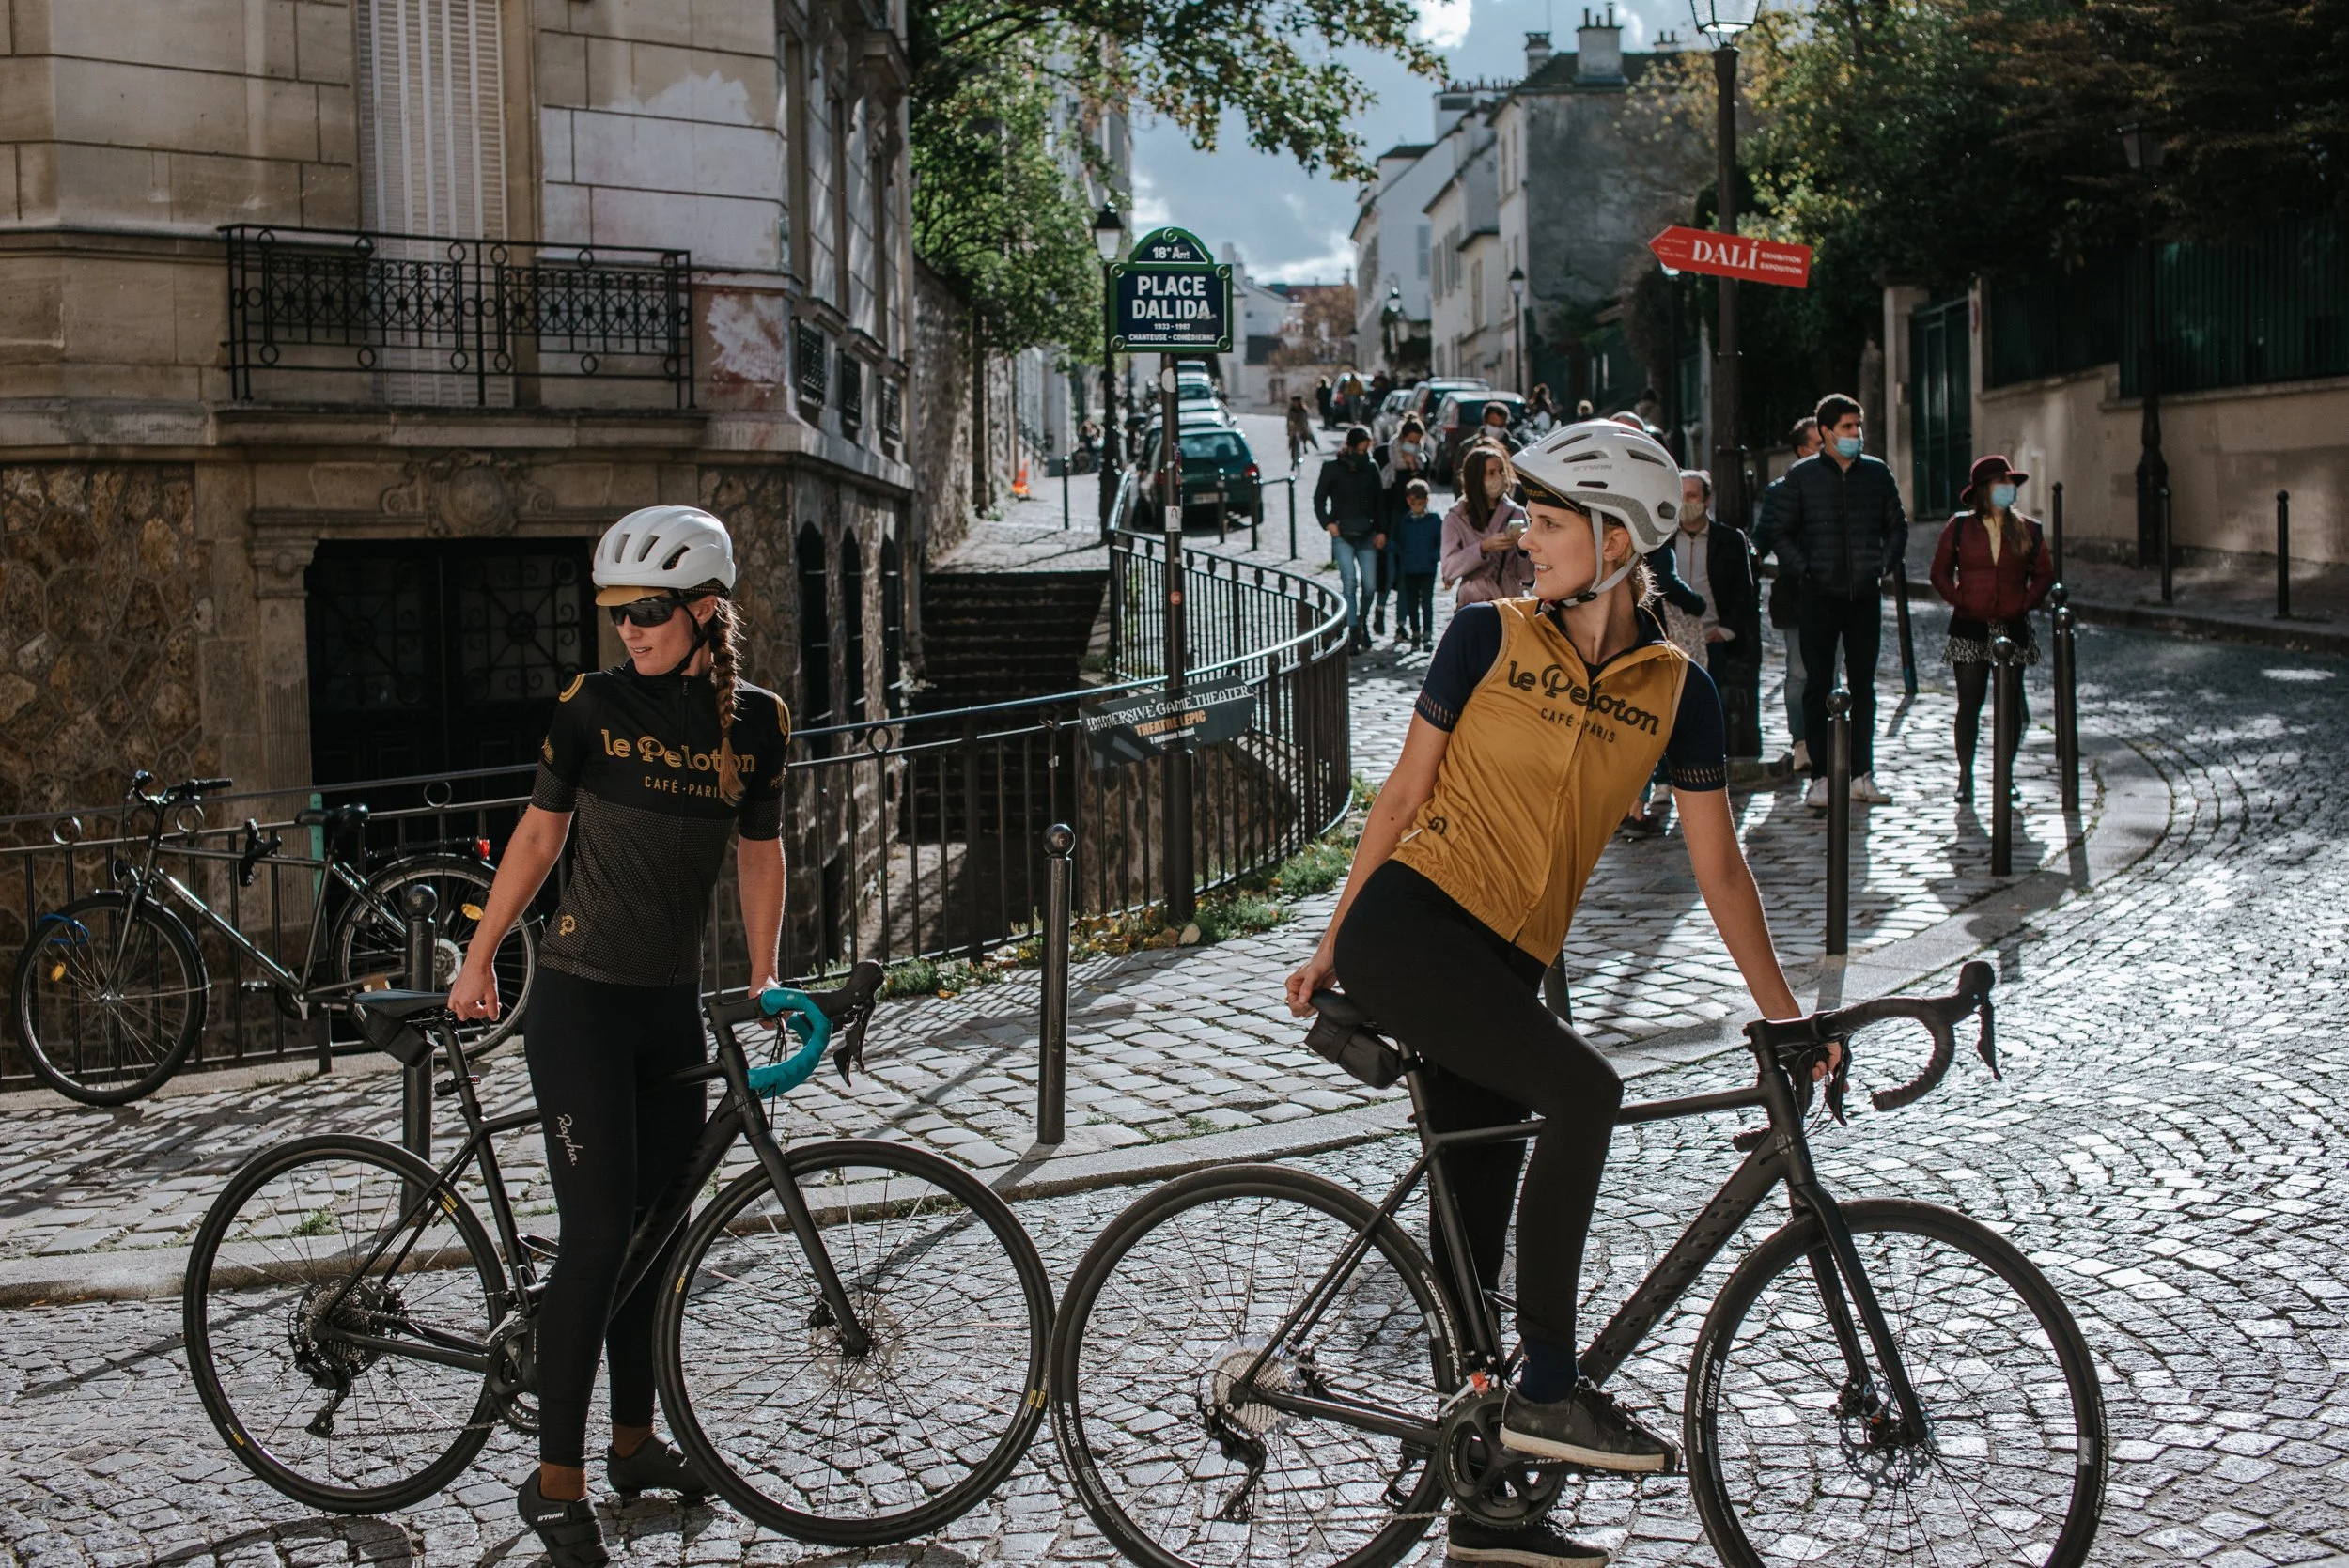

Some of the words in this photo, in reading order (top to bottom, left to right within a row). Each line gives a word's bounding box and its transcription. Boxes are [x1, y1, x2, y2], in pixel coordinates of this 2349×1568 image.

[1692, 240, 1759, 270] DALÍ
[1759, 262, 1803, 274] EXPOSITION
[1761, 252, 1802, 263] EXHIBITION
[1137, 275, 1206, 296] PLACE
[1132, 299, 1211, 319] DALIDA
[1086, 705, 1154, 731] IMMERSIVE
[1156, 696, 1192, 715] GAME
[1193, 685, 1252, 707] THEATER
[1508, 660, 1536, 691] le
[1541, 663, 1660, 736] Peloton
[1134, 717, 1178, 737] THEATRE
[1179, 710, 1206, 728] LEPIC
[1541, 707, 1573, 728] CAFÉ
[1583, 722, 1616, 743] PARIS
[600, 729, 631, 757] le
[645, 776, 677, 793] CAFÉ
[689, 784, 722, 798] PARI
[1425, 1280, 1460, 1374] CONTINENTAL
[1711, 1358, 1722, 1379] DT
[1706, 1377, 1719, 1410] SWISS
[1063, 1401, 1073, 1418] DT
[1065, 1419, 1080, 1448] SWISS
